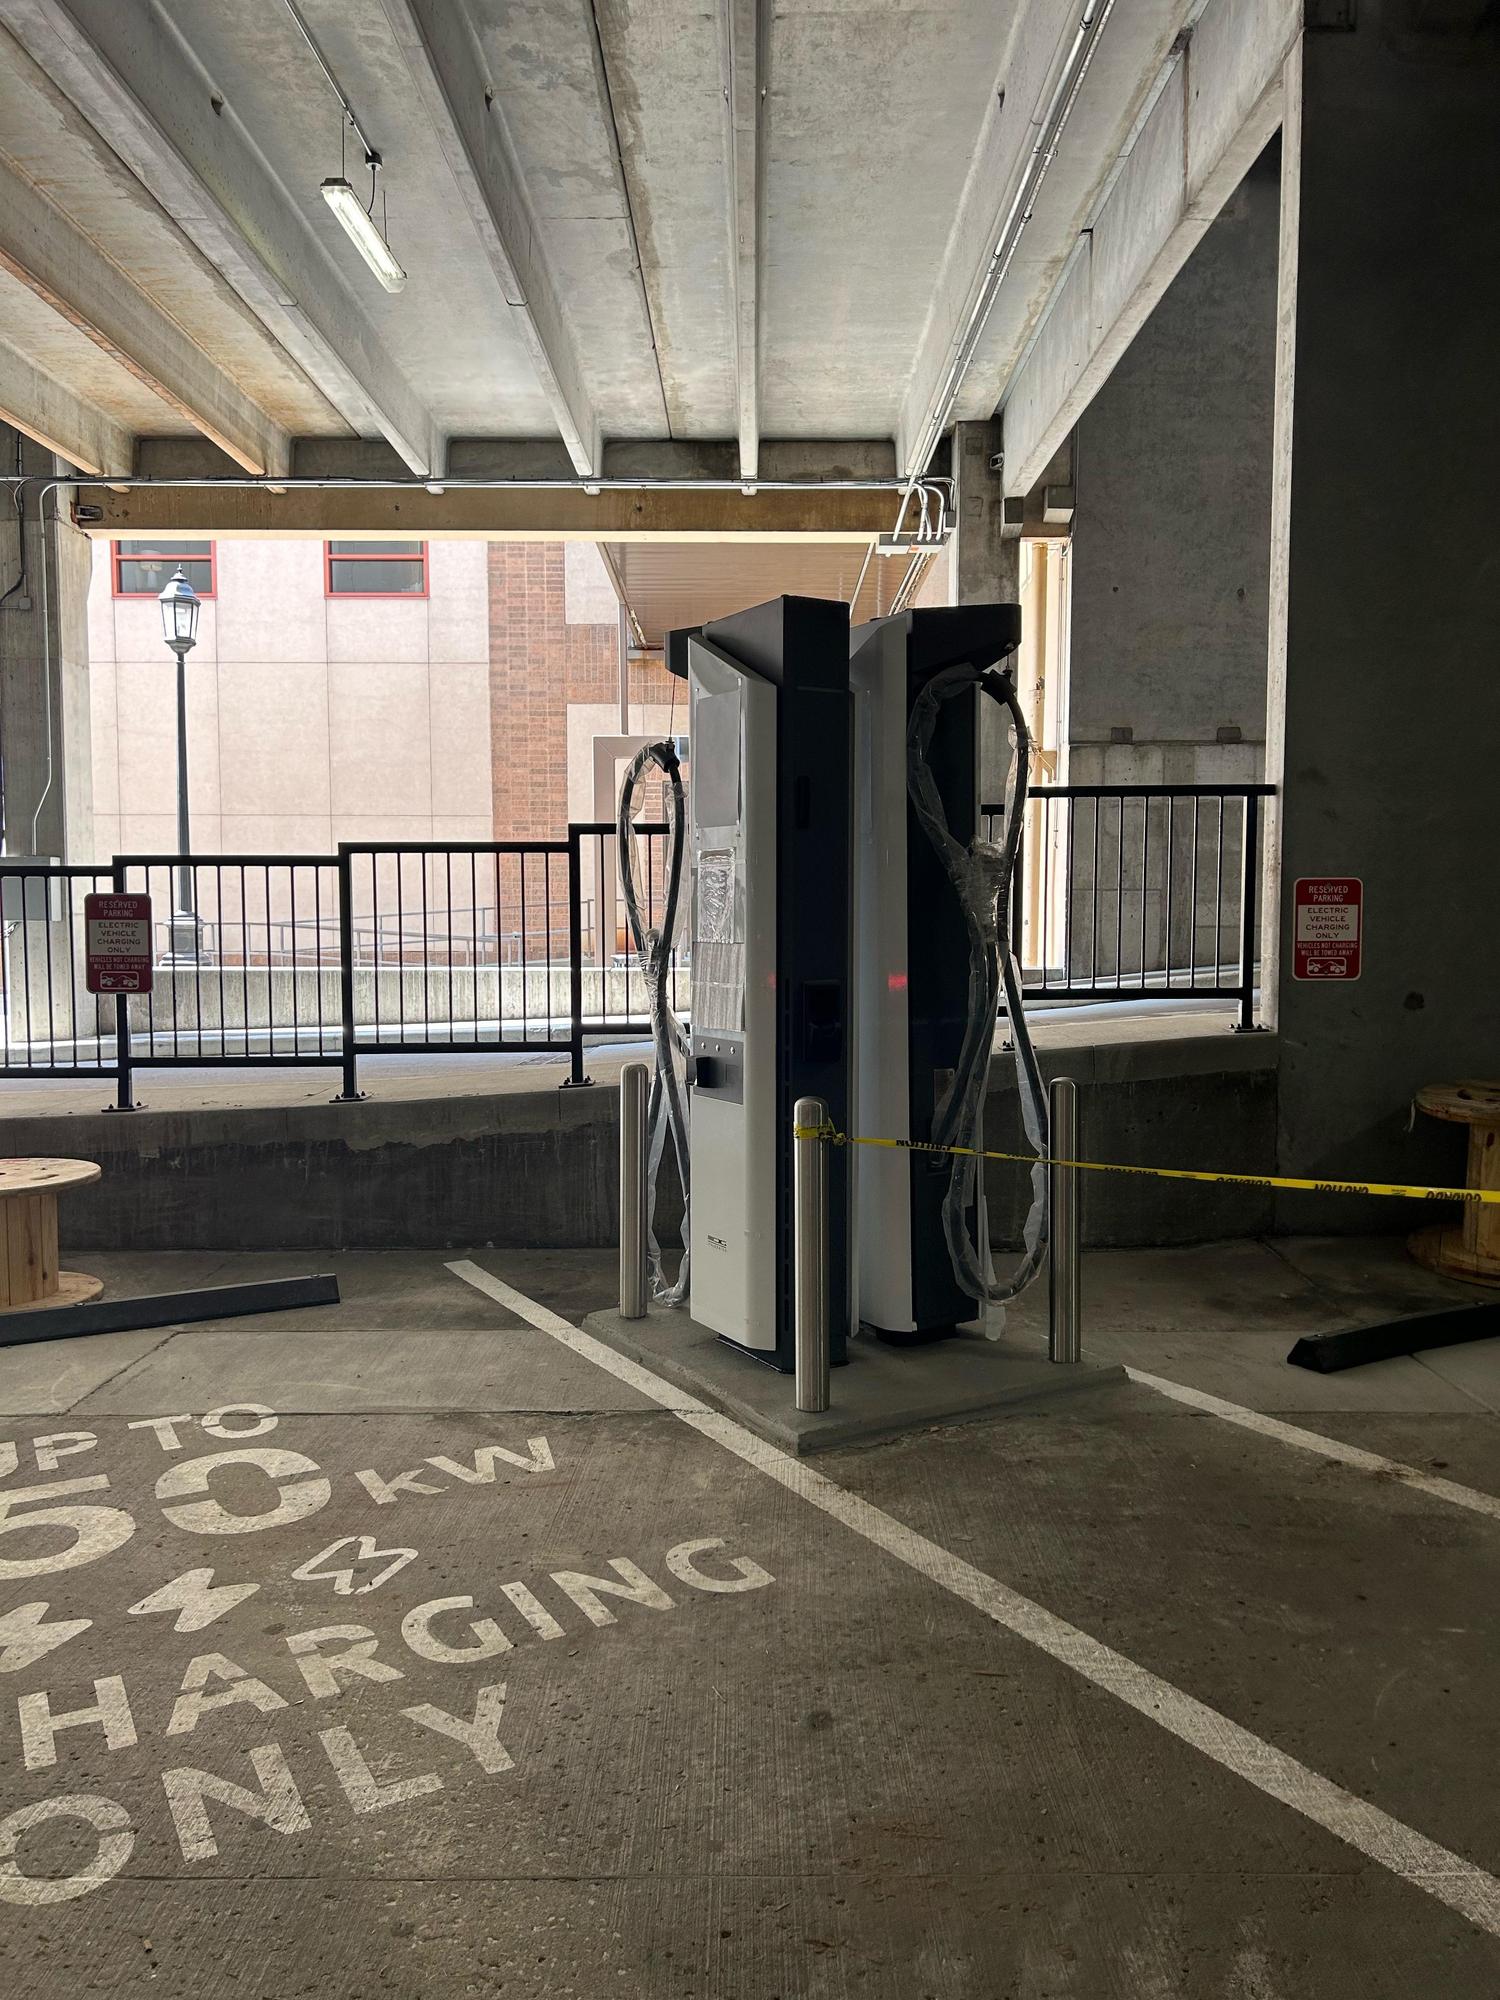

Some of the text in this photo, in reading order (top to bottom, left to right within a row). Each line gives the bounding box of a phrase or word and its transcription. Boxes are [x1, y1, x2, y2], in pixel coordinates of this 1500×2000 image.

[1308, 885, 1349, 894] RESERVED
[98, 900, 138, 909] RESERVED
[103, 909, 134, 918] PARKING
[98, 921, 139, 929] ELECTRIC
[127, 1403, 279, 1451] TO
[0, 1682, 515, 1905] ONLY
